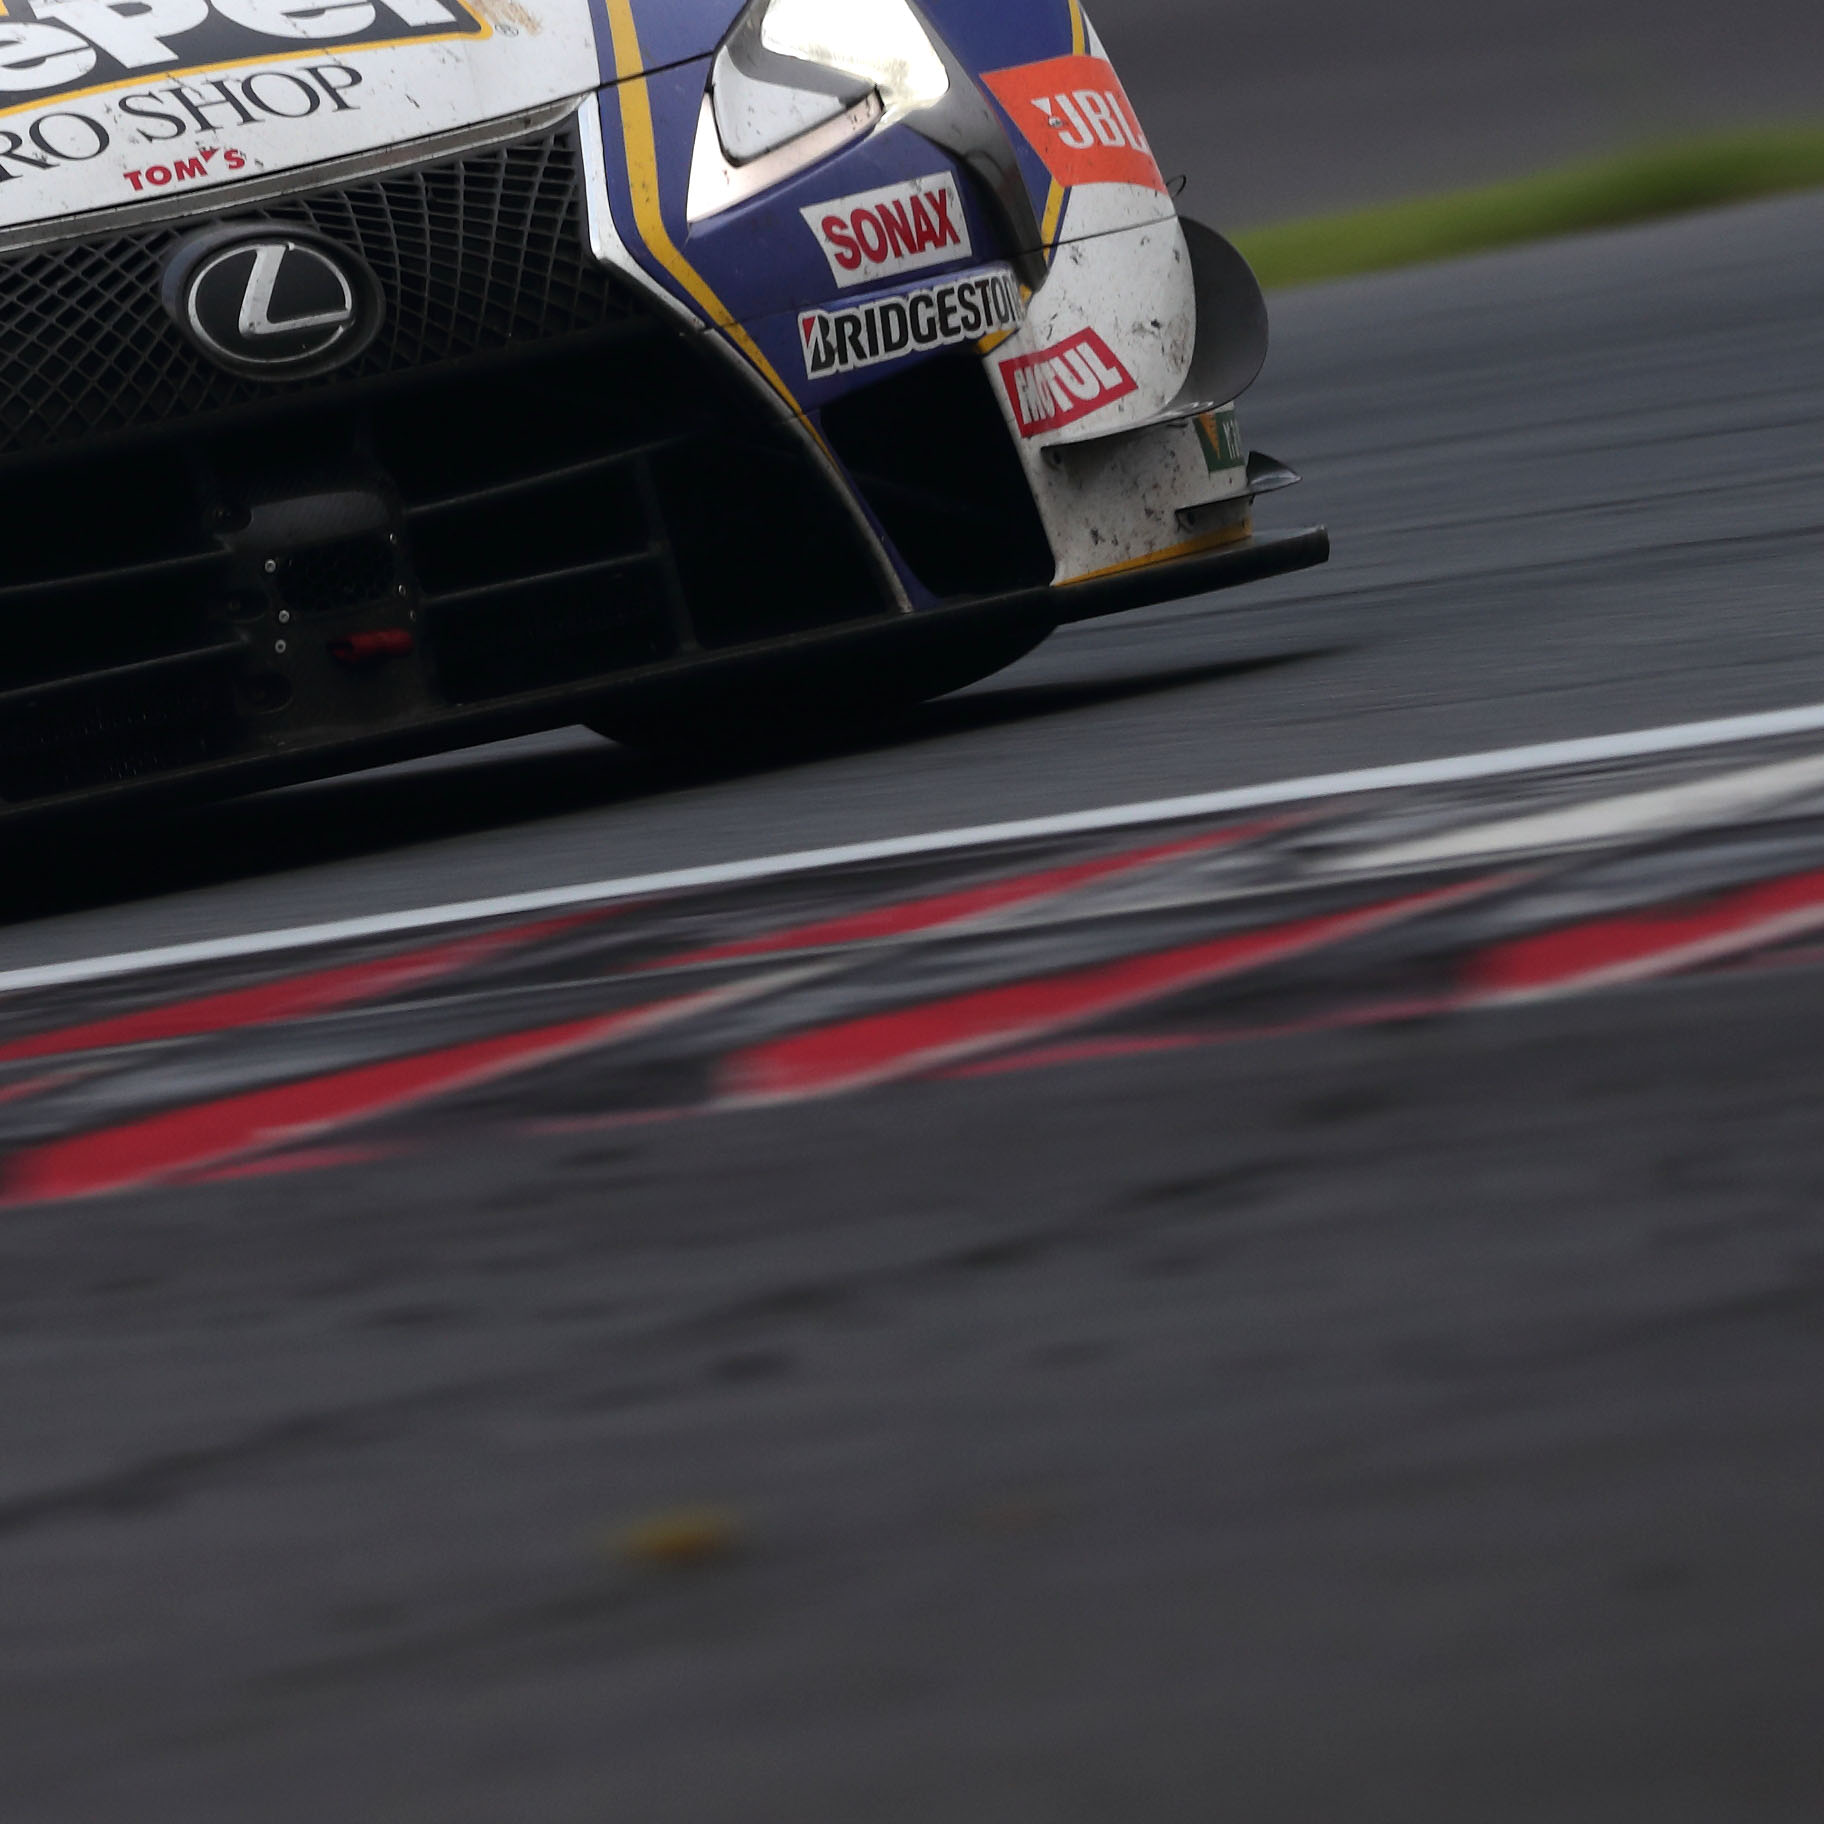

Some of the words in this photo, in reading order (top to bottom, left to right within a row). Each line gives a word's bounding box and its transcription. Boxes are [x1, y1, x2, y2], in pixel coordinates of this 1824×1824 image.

[118, 63, 365, 145] SHOP
[1030, 88, 1150, 149] JBL
[123, 148, 246, 192] TOM'S
[820, 188, 960, 273] SONAX
[1012, 341, 1124, 426] MOTUL
